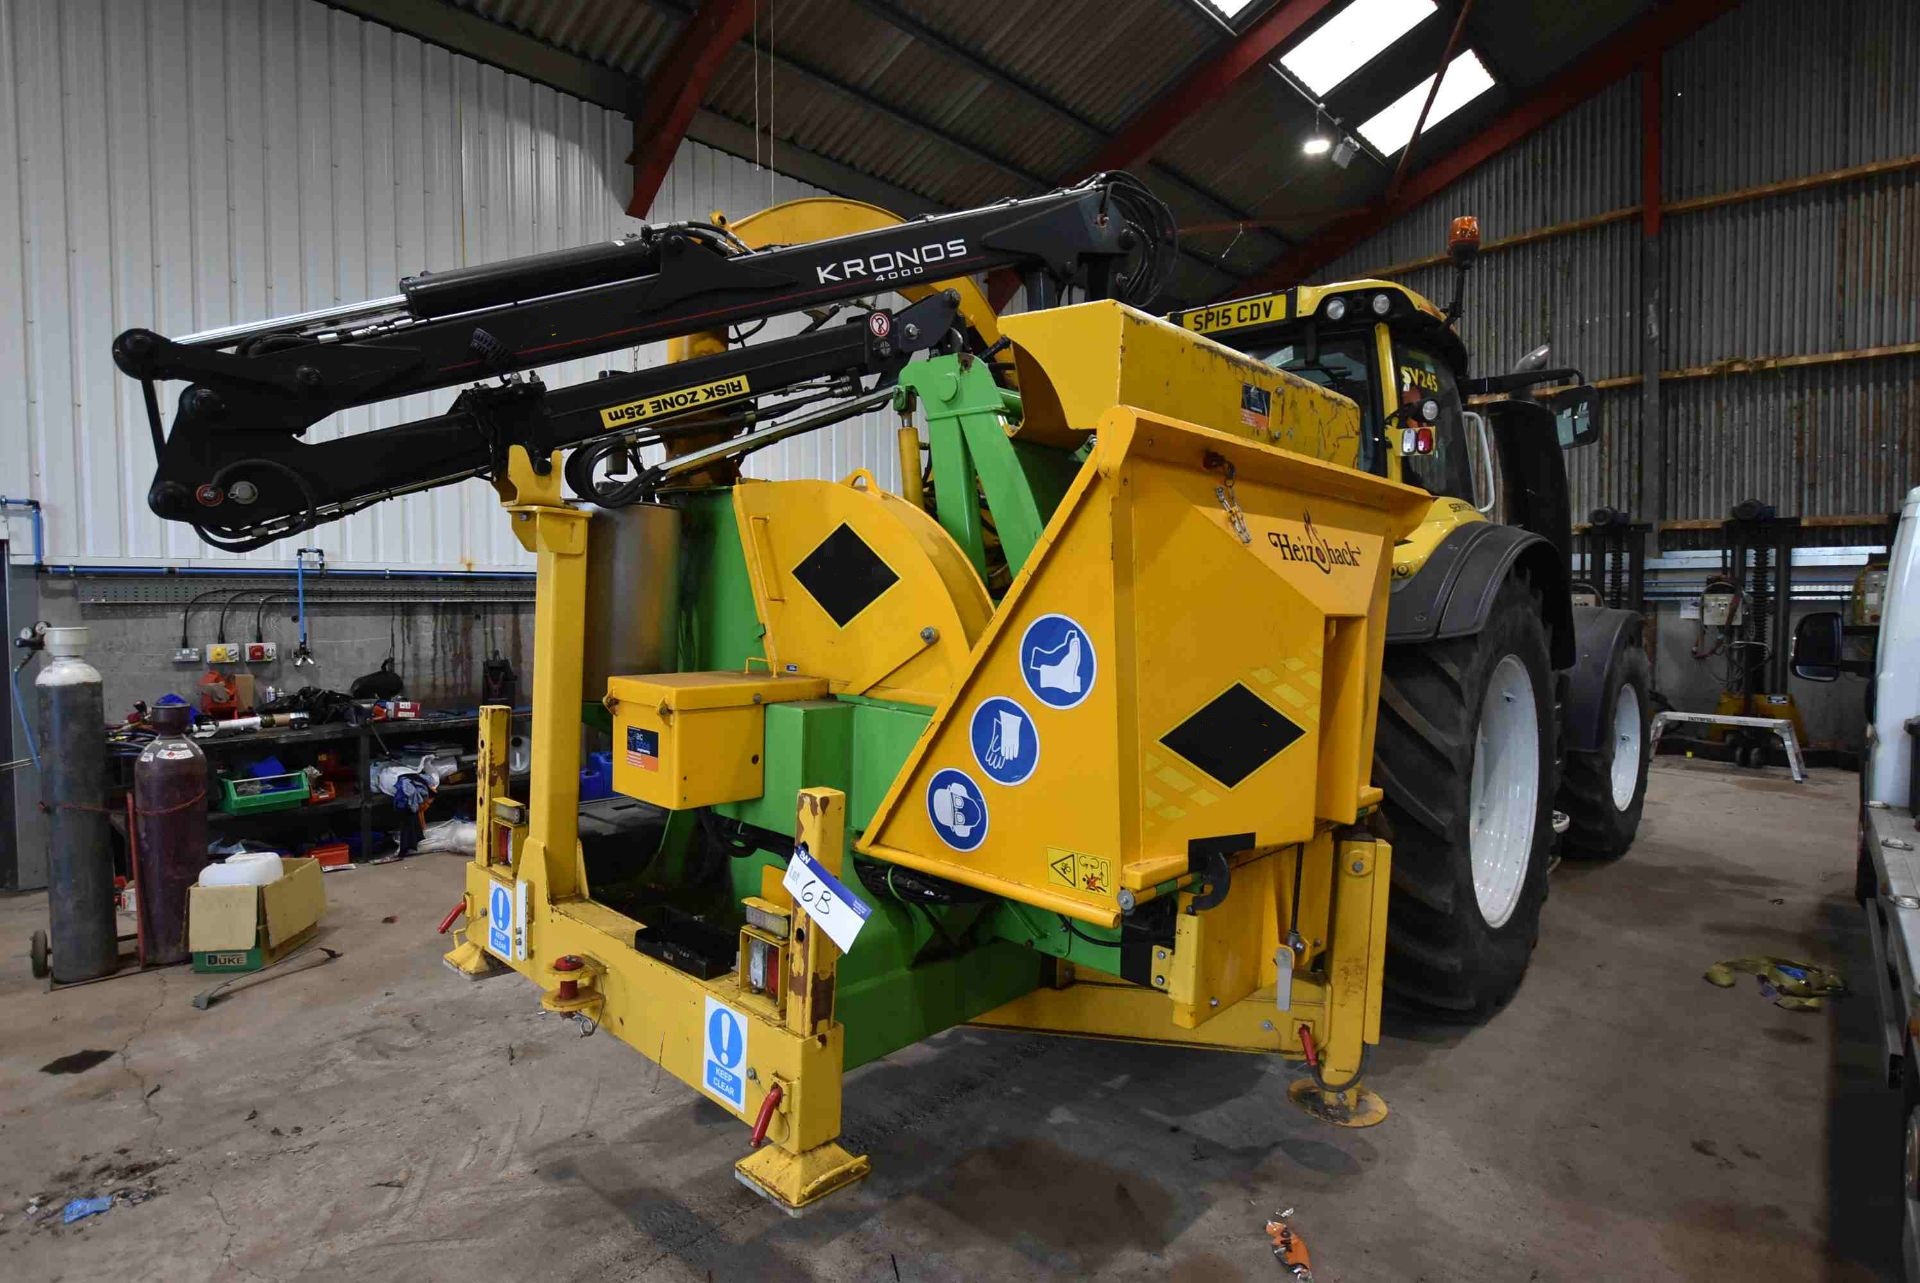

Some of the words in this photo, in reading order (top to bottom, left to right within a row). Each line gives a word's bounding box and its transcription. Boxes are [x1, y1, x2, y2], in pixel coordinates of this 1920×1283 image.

[816, 238, 967, 284] KRONOS
[875, 266, 924, 282] 4000
[1193, 308, 1232, 332] SP15
[1237, 300, 1273, 323] CDV
[701, 379, 743, 400] RISK
[649, 390, 700, 414] ZONE
[608, 404, 647, 422] 25m
[801, 880, 831, 915] 6B
[715, 1066, 733, 1081] KEEP
[713, 1076, 735, 1097] CLEAR
